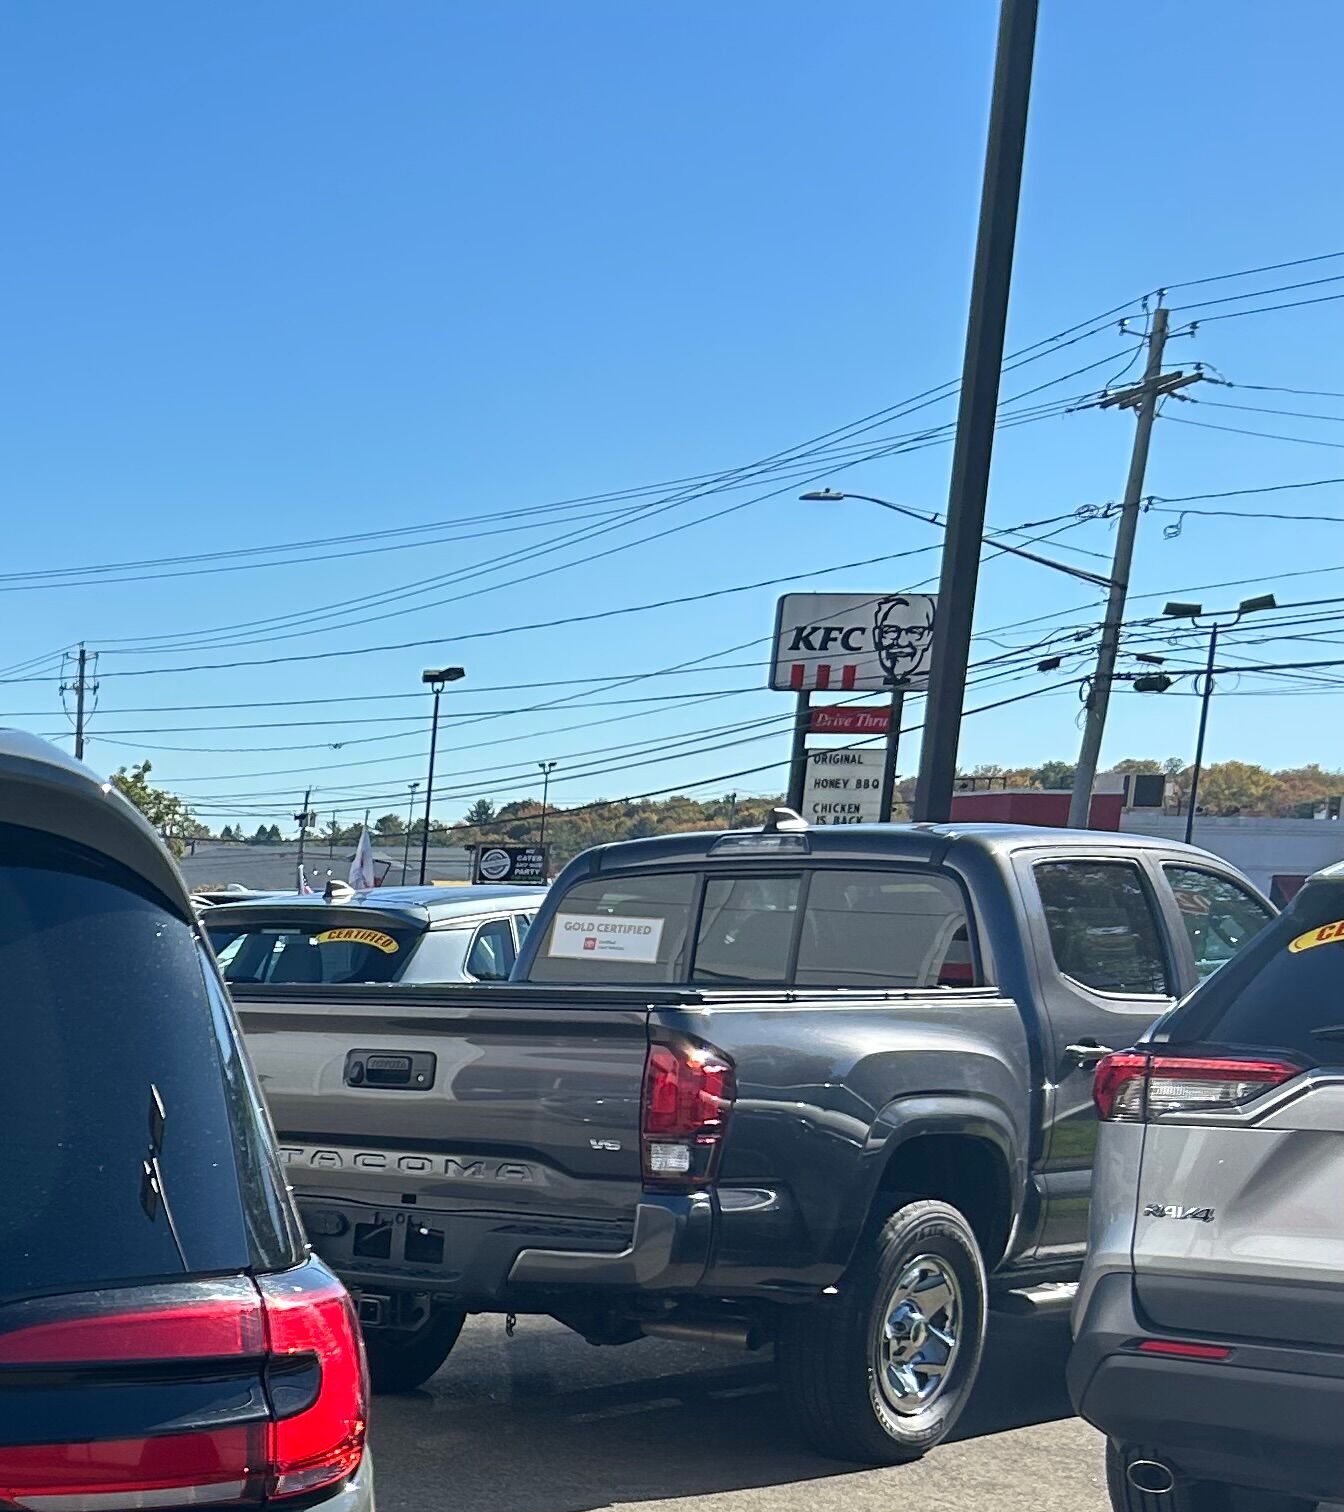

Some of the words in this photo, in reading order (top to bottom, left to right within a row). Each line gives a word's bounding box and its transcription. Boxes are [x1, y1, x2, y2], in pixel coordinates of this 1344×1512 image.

[787, 626, 868, 651] KFC
[815, 713, 852, 727] Drive
[856, 713, 889, 728] Thru
[813, 753, 863, 765] ORIGINAL
[813, 778, 849, 789] HONEY
[855, 779, 880, 789] BBQ
[813, 802, 861, 814] CHICKEN
[564, 921, 595, 932] GOLD
[597, 923, 652, 935] CERTIFIED
[327, 929, 394, 948] CERTIFIED
[279, 1147, 534, 1183] TACOMA
[1143, 1204, 1215, 1223] RAV4
